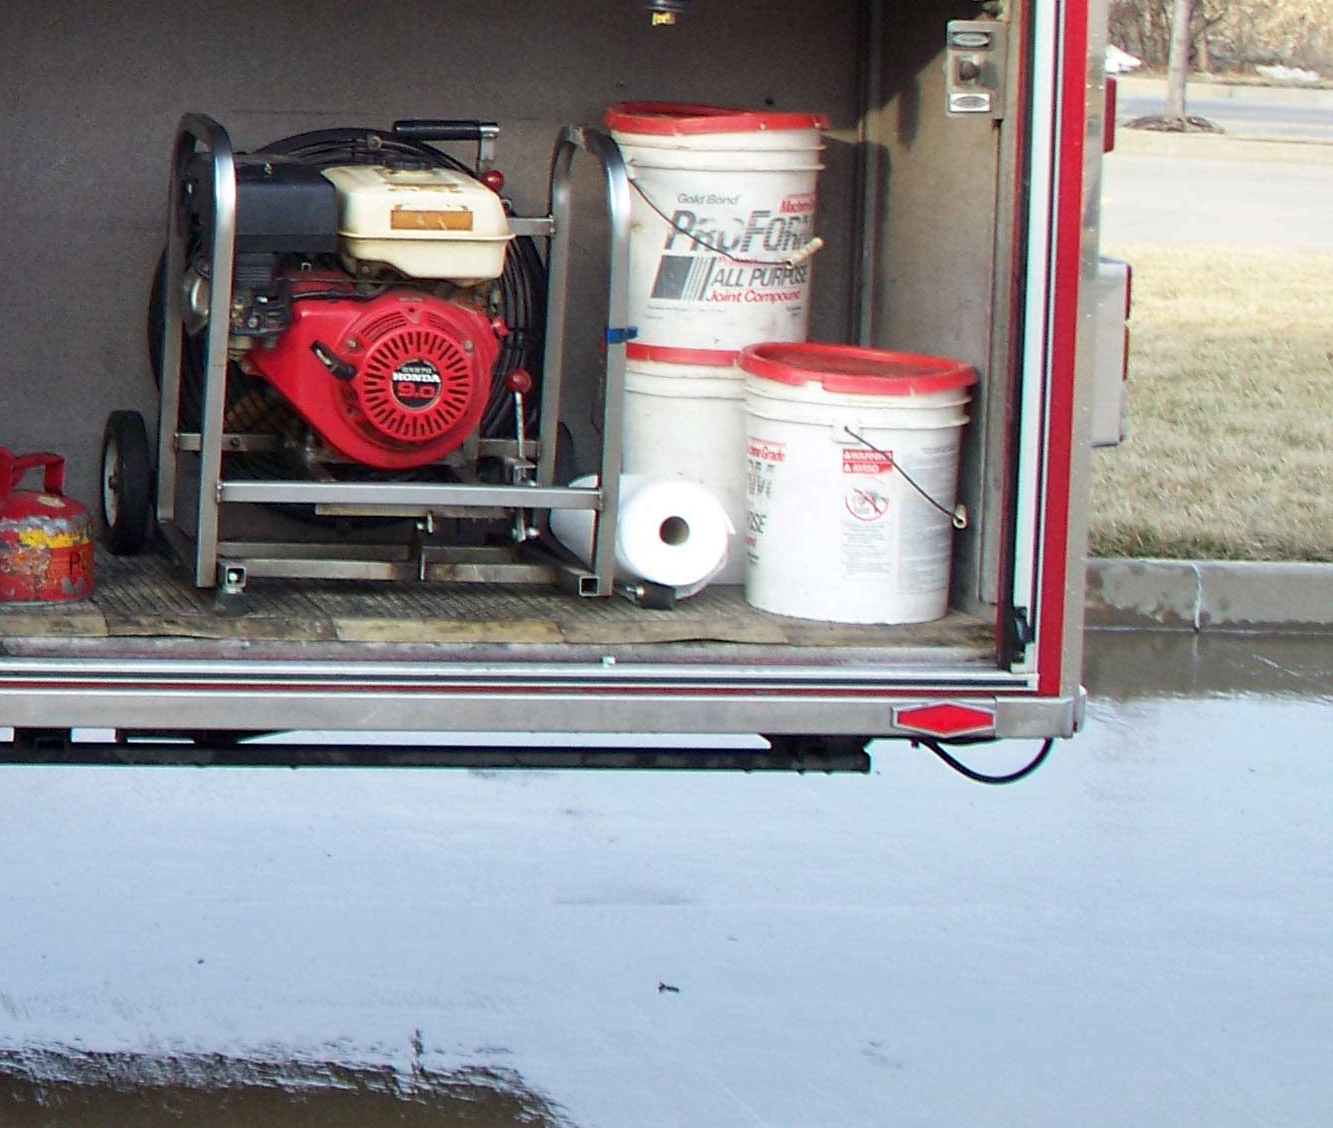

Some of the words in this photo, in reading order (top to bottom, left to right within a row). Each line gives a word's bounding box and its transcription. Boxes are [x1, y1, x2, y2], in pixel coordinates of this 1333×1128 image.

[677, 193, 705, 204] Gold
[706, 194, 742, 205] Bond
[711, 268, 744, 287] ALL
[706, 290, 742, 303] Joint
[393, 372, 441, 382] HONDA
[398, 382, 436, 398] 9.0
